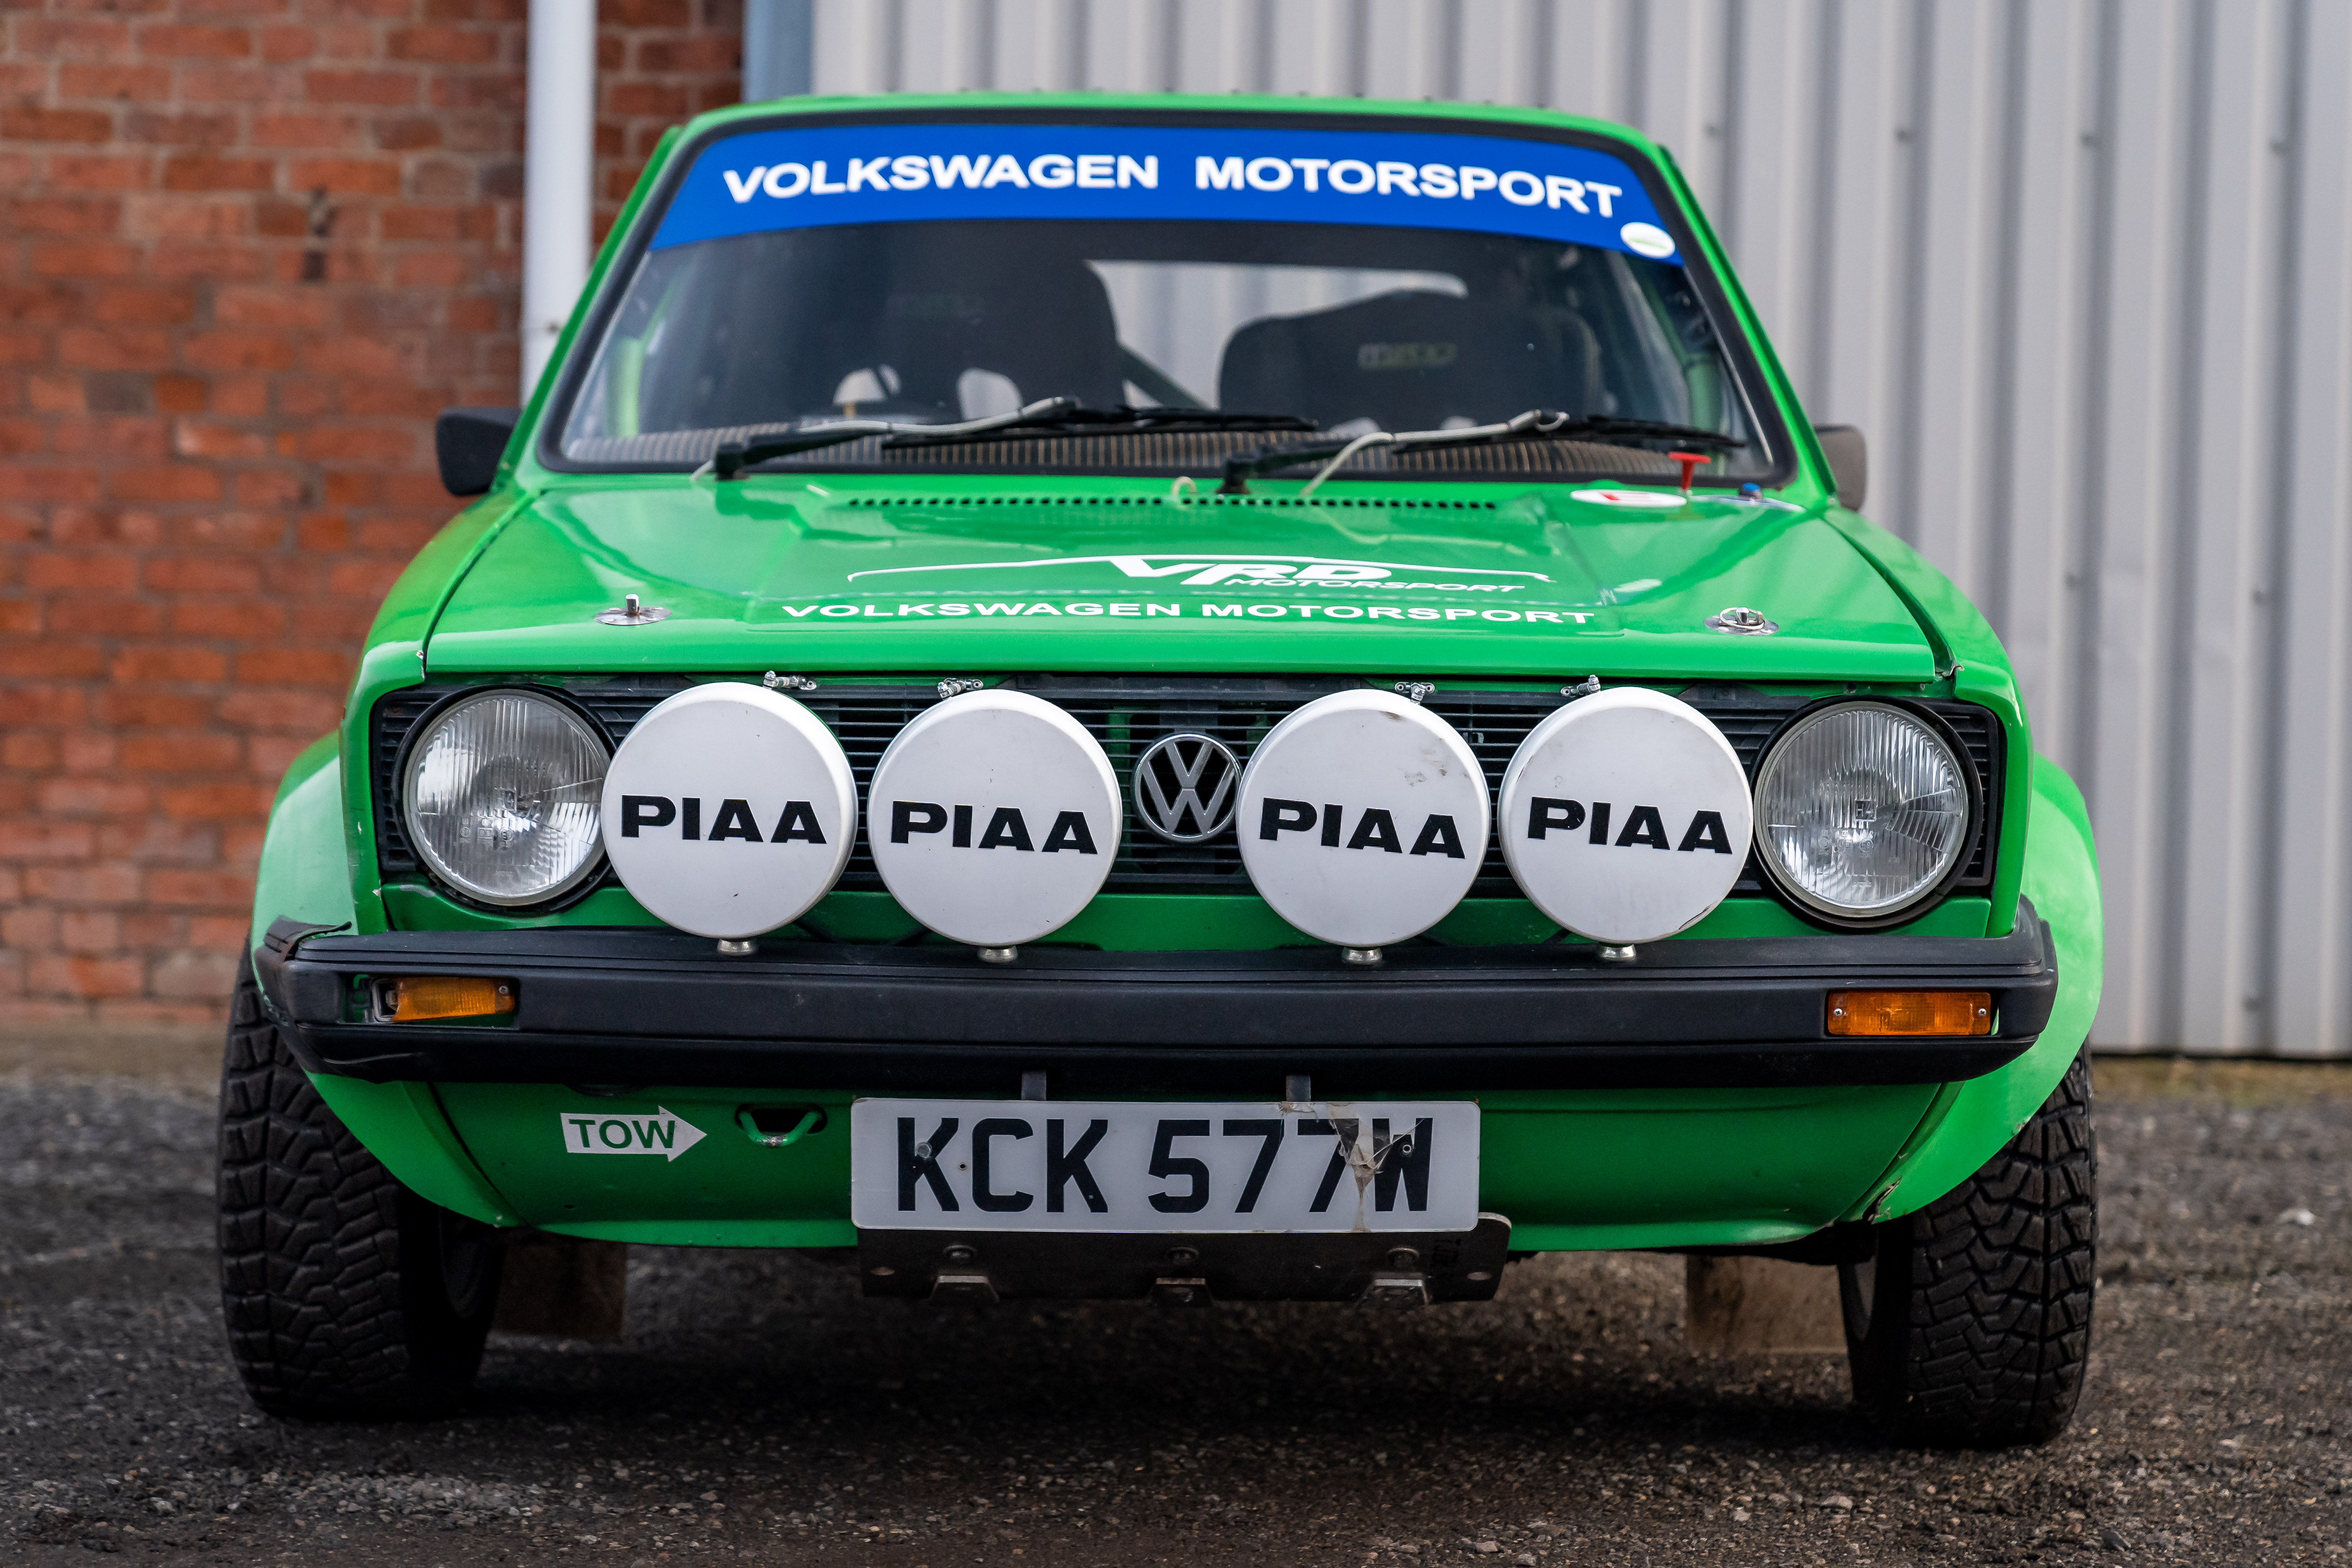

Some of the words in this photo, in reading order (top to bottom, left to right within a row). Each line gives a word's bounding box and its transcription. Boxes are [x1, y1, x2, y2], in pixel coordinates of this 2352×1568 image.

[723, 154, 1159, 204] VOLKSWAGEN
[1195, 156, 1623, 218] MOTORSPORT
[1110, 556, 1392, 586] VRD
[1223, 578, 1526, 593] MOTORSPORT
[781, 602, 1181, 618] VOLKSWAGEN
[1201, 604, 1595, 624] MOTORSPORT
[621, 794, 828, 845] PIAA
[890, 800, 1098, 855] PIAA
[1259, 797, 1466, 860] PIAA
[1527, 796, 1733, 855] PIAA
[569, 1119, 676, 1149] TOW
[897, 1117, 1109, 1214] KCK
[1147, 1117, 1434, 1214] 577W
